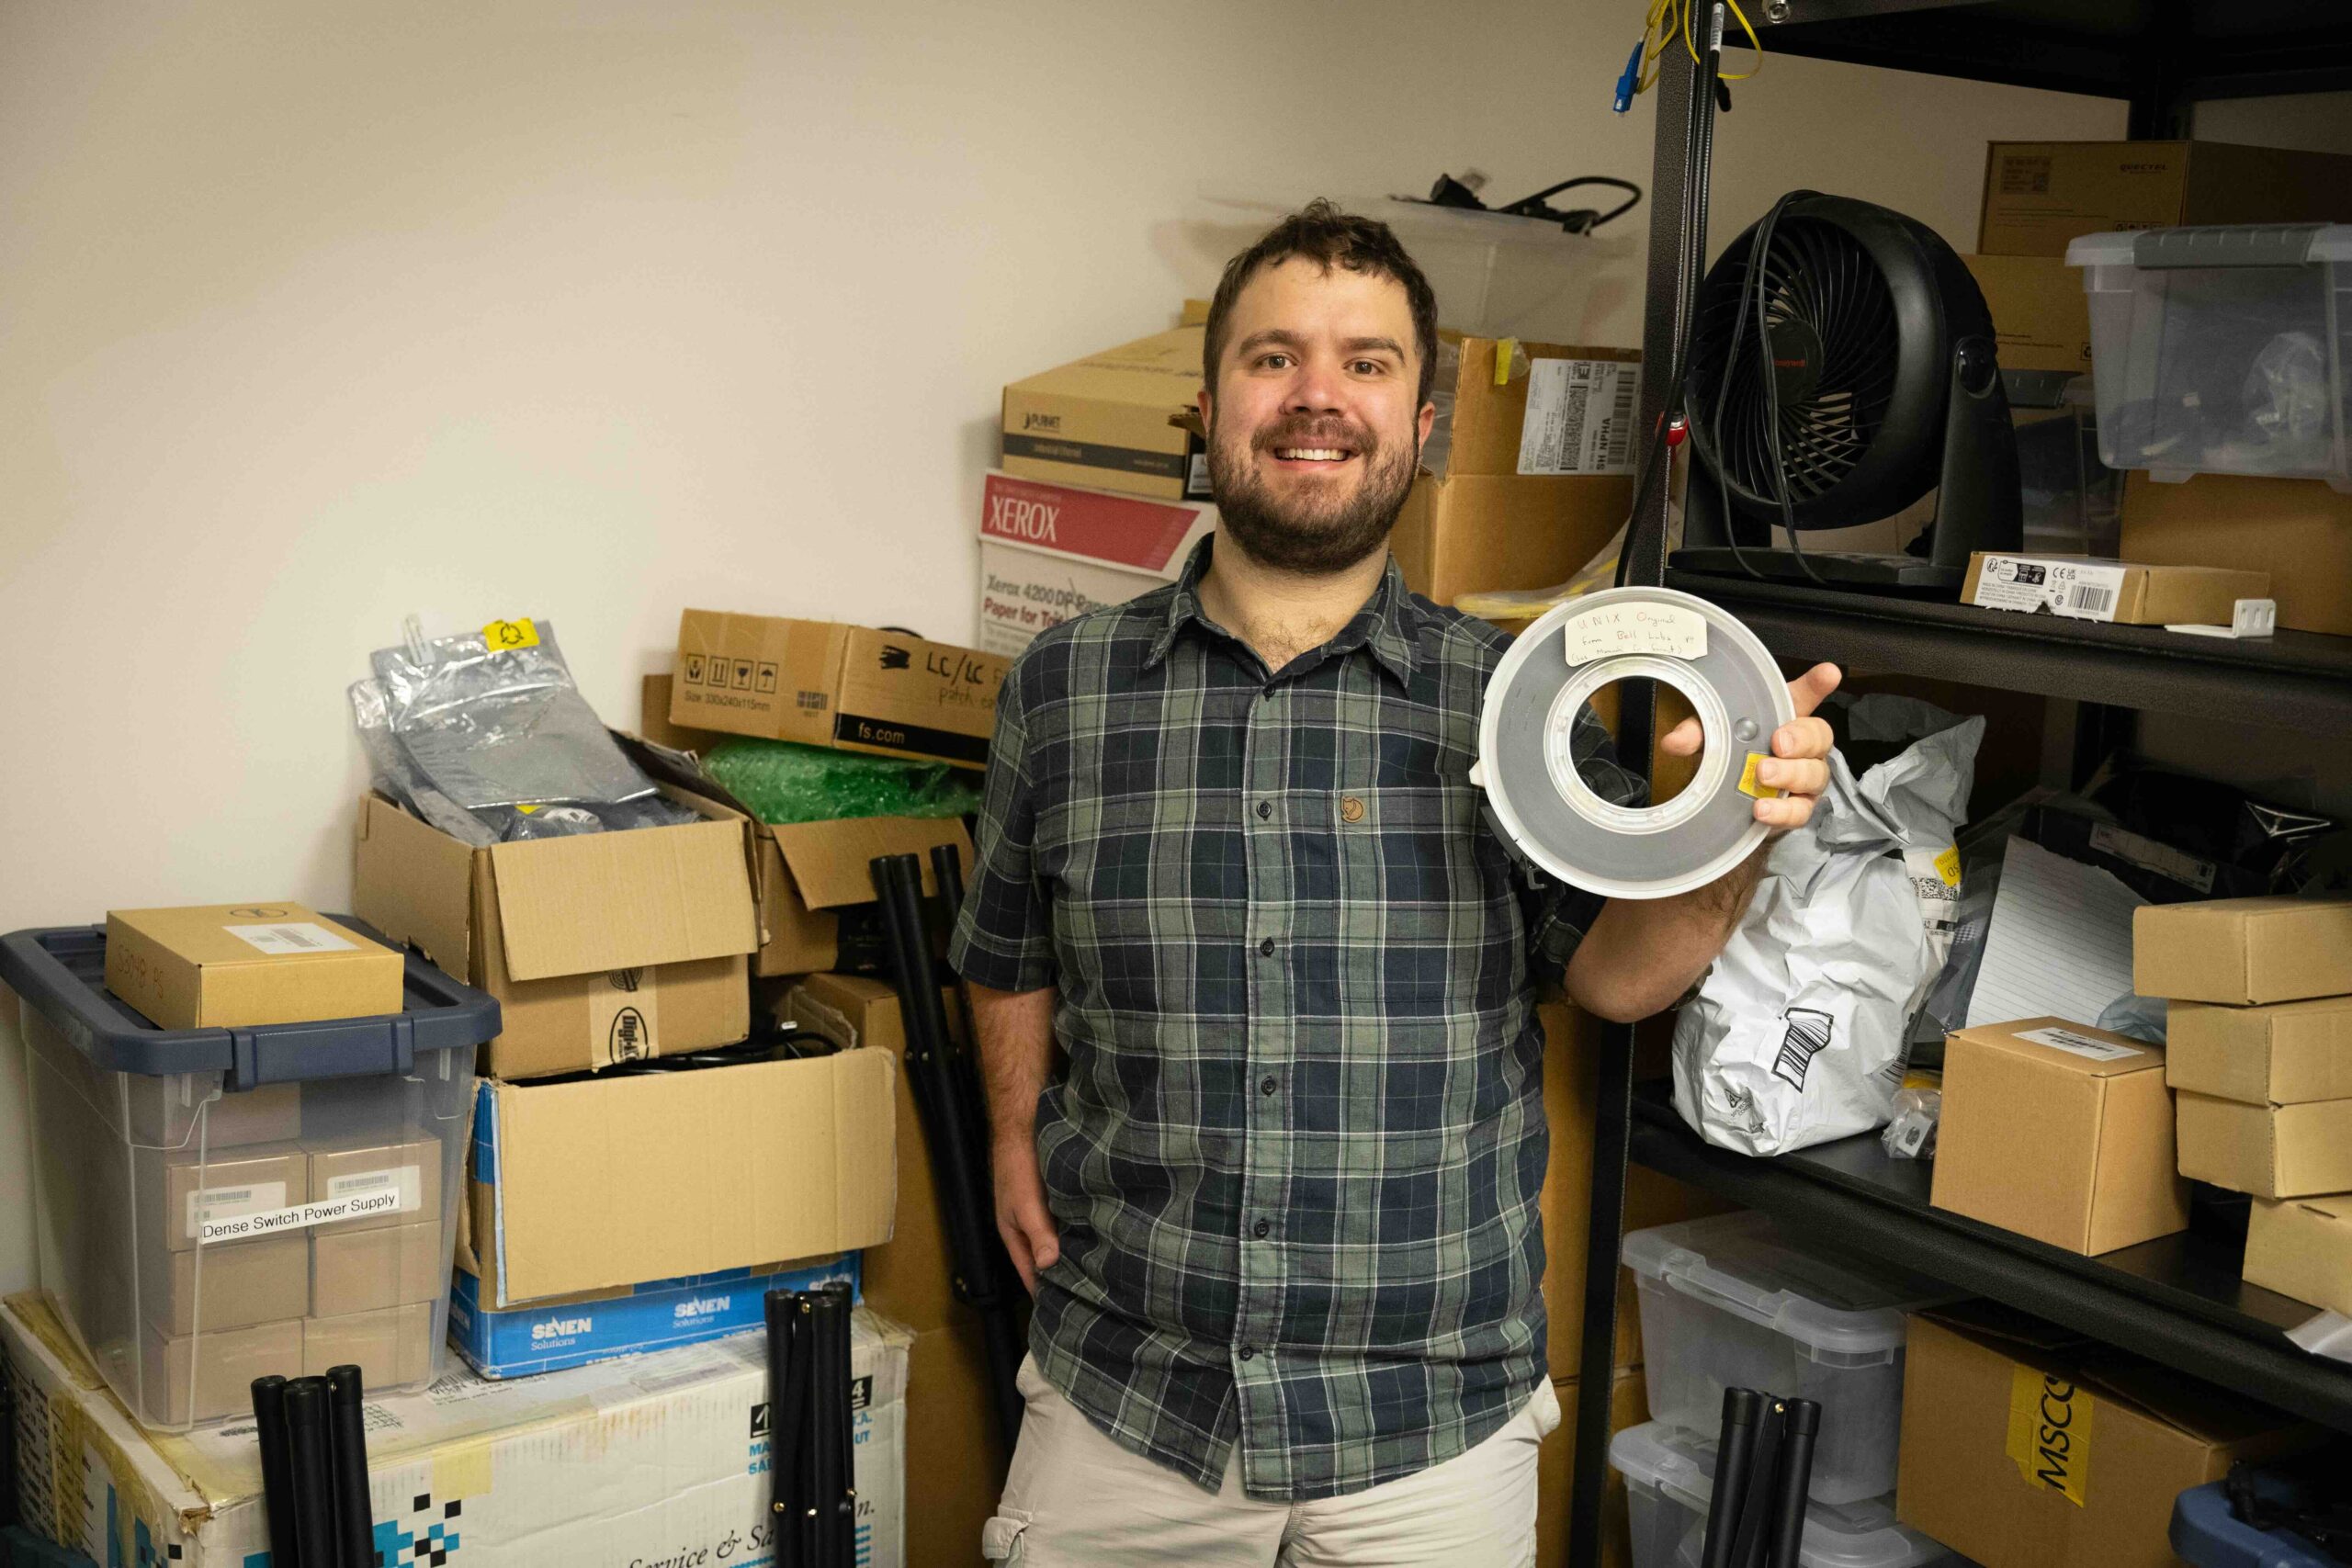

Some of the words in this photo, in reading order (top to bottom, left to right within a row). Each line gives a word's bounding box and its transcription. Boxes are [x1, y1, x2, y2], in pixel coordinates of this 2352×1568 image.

[988, 495, 1060, 543] XEROX
[986, 574, 1021, 596] Xerox
[984, 595, 1019, 620] Paper
[1020, 606, 1038, 625] for
[1577, 613, 1620, 630] UNIX
[1635, 611, 1676, 627] Original
[1616, 630, 1637, 641] Bell
[857, 721, 905, 745] fs.com
[618, 1015, 640, 1061] Digi-K
[203, 1222, 249, 1238] Dense
[254, 1212, 300, 1230] Switch
[304, 1204, 346, 1221] Power
[350, 1193, 396, 1213] Supply
[673, 1295, 731, 1318] SEVEN
[531, 1316, 592, 1340] SEVEN
[673, 1314, 716, 1328] Solutions
[530, 1337, 576, 1351] Solutions
[749, 1439, 773, 1457] MA
[628, 1547, 707, 1568] rvice
[717, 1529, 741, 1559] &
[747, 1524, 775, 1551] Sa
